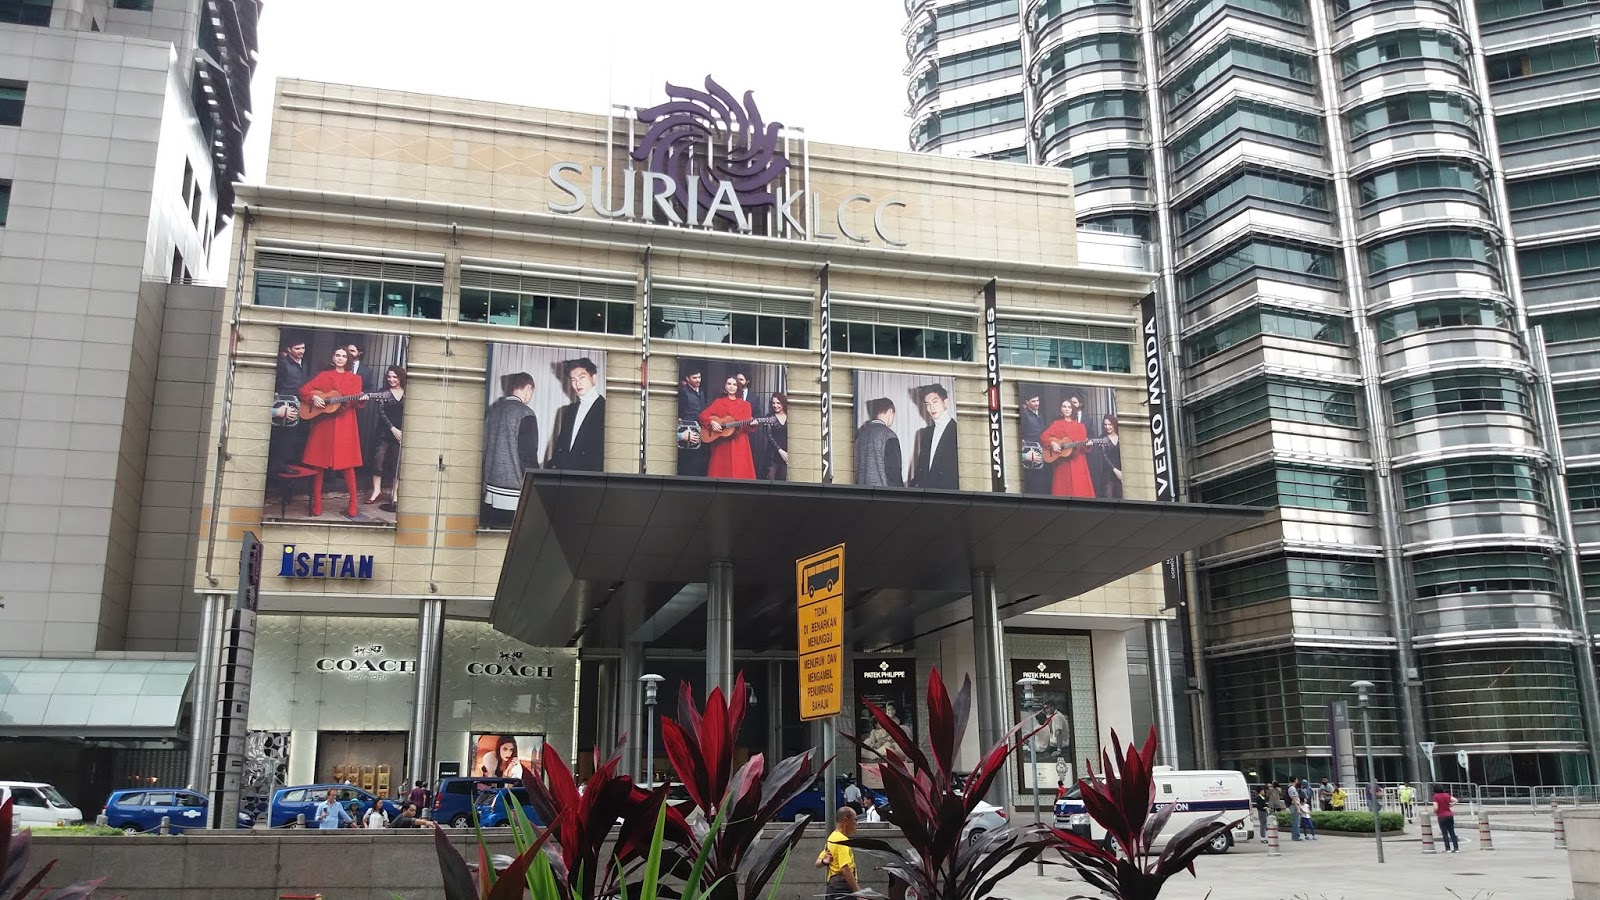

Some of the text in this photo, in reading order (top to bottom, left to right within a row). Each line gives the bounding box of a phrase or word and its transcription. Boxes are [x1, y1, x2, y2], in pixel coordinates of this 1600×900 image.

[547, 161, 907, 246] SURIA KLCC
[986, 307, 1002, 478] JACK JONES
[1145, 316, 1168, 497] VERO MODA
[821, 391, 829, 478] VERO
[814, 605, 828, 617] TIDAK
[803, 617, 837, 635] DI BENARKAN
[807, 632, 833, 647] MENUNGGU
[316, 659, 416, 671] COACH
[803, 653, 837, 670] MENURUN DAN
[467, 662, 554, 677] COACH
[807, 669, 833, 683] MENGAMBIL
[807, 683, 834, 697] PENUMPANG
[812, 699, 829, 711] SAHAJA
